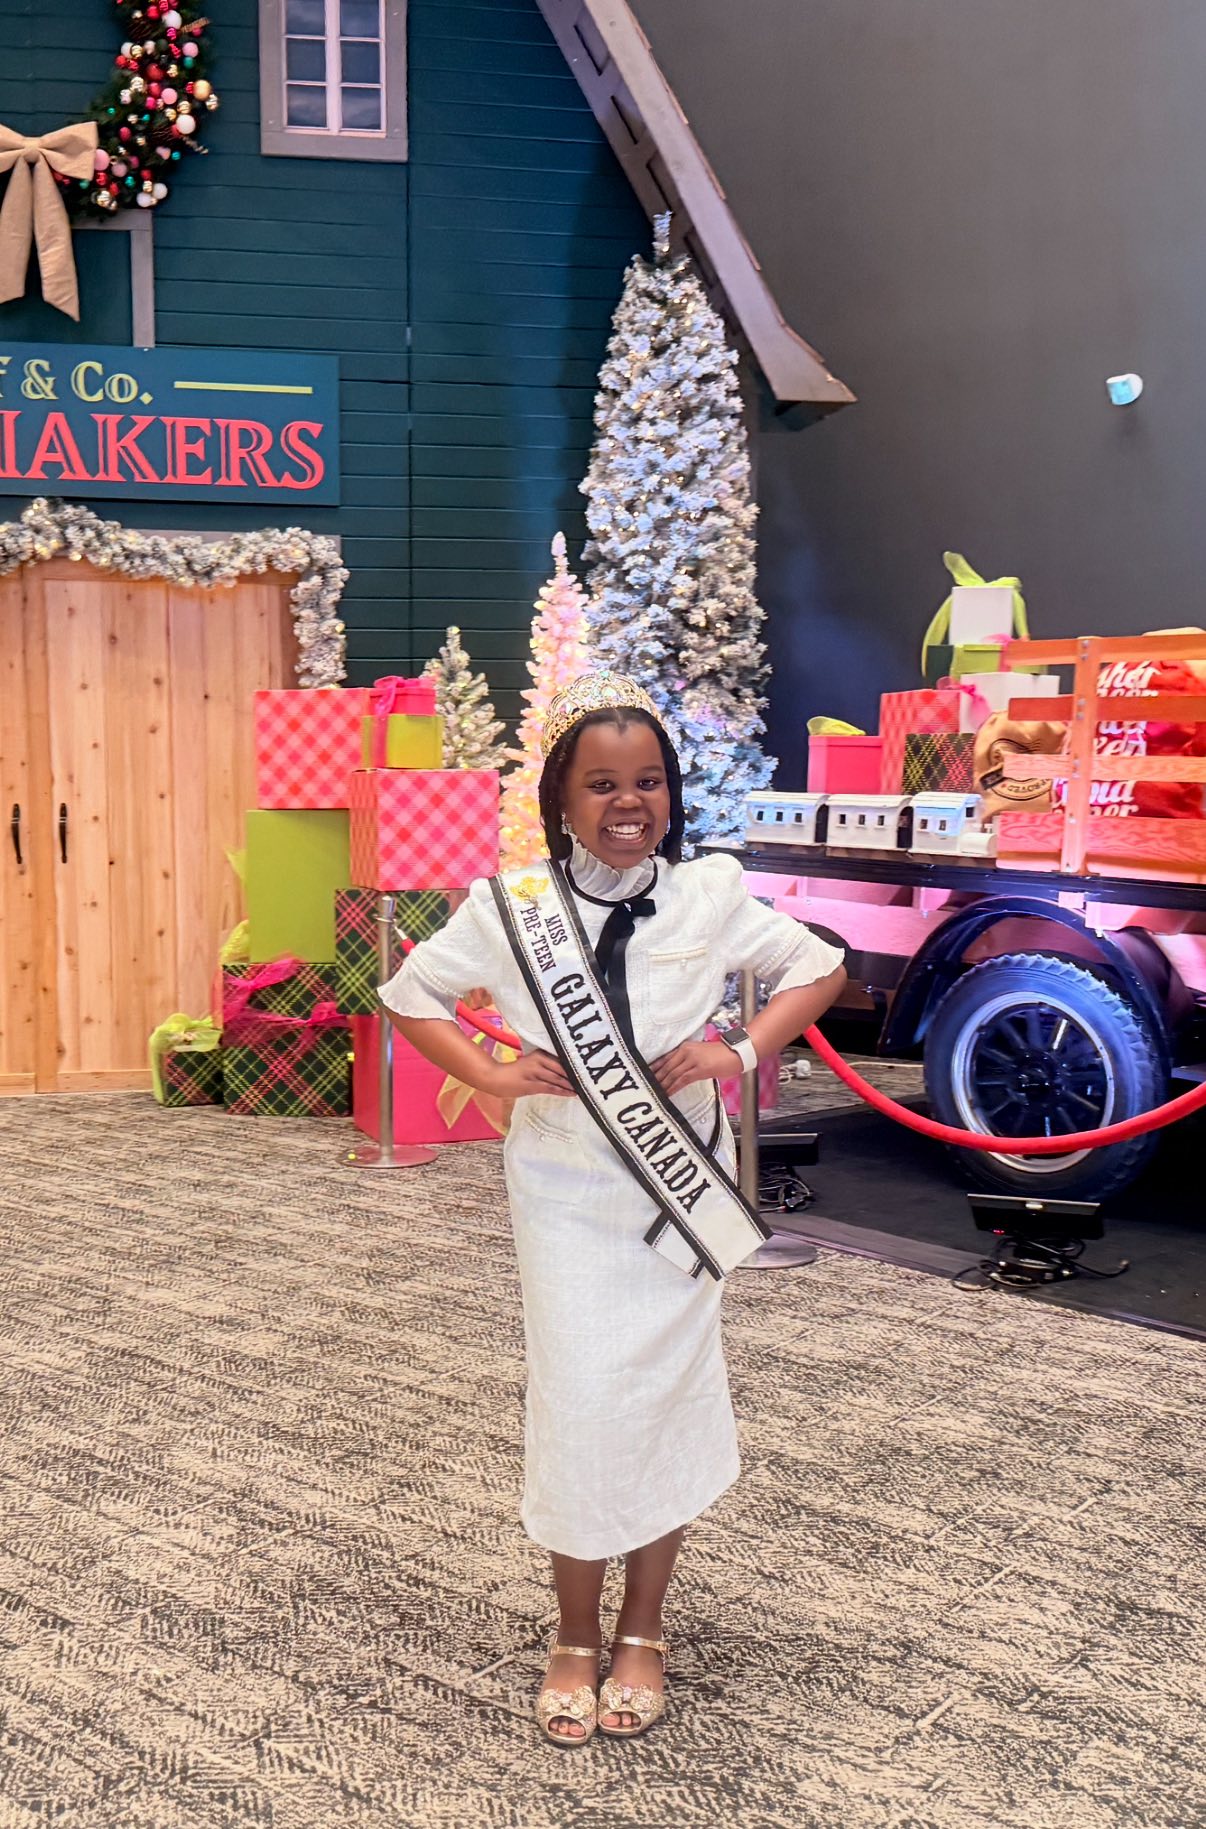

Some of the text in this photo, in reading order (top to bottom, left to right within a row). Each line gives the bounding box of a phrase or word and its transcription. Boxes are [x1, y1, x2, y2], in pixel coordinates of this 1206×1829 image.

[21, 359, 59, 400] &
[70, 360, 153, 405] Co.
[520, 907, 556, 973] PRE-TEEN
[544, 914, 568, 946] MISS
[550, 973, 711, 1214] GALAXY CANADA
